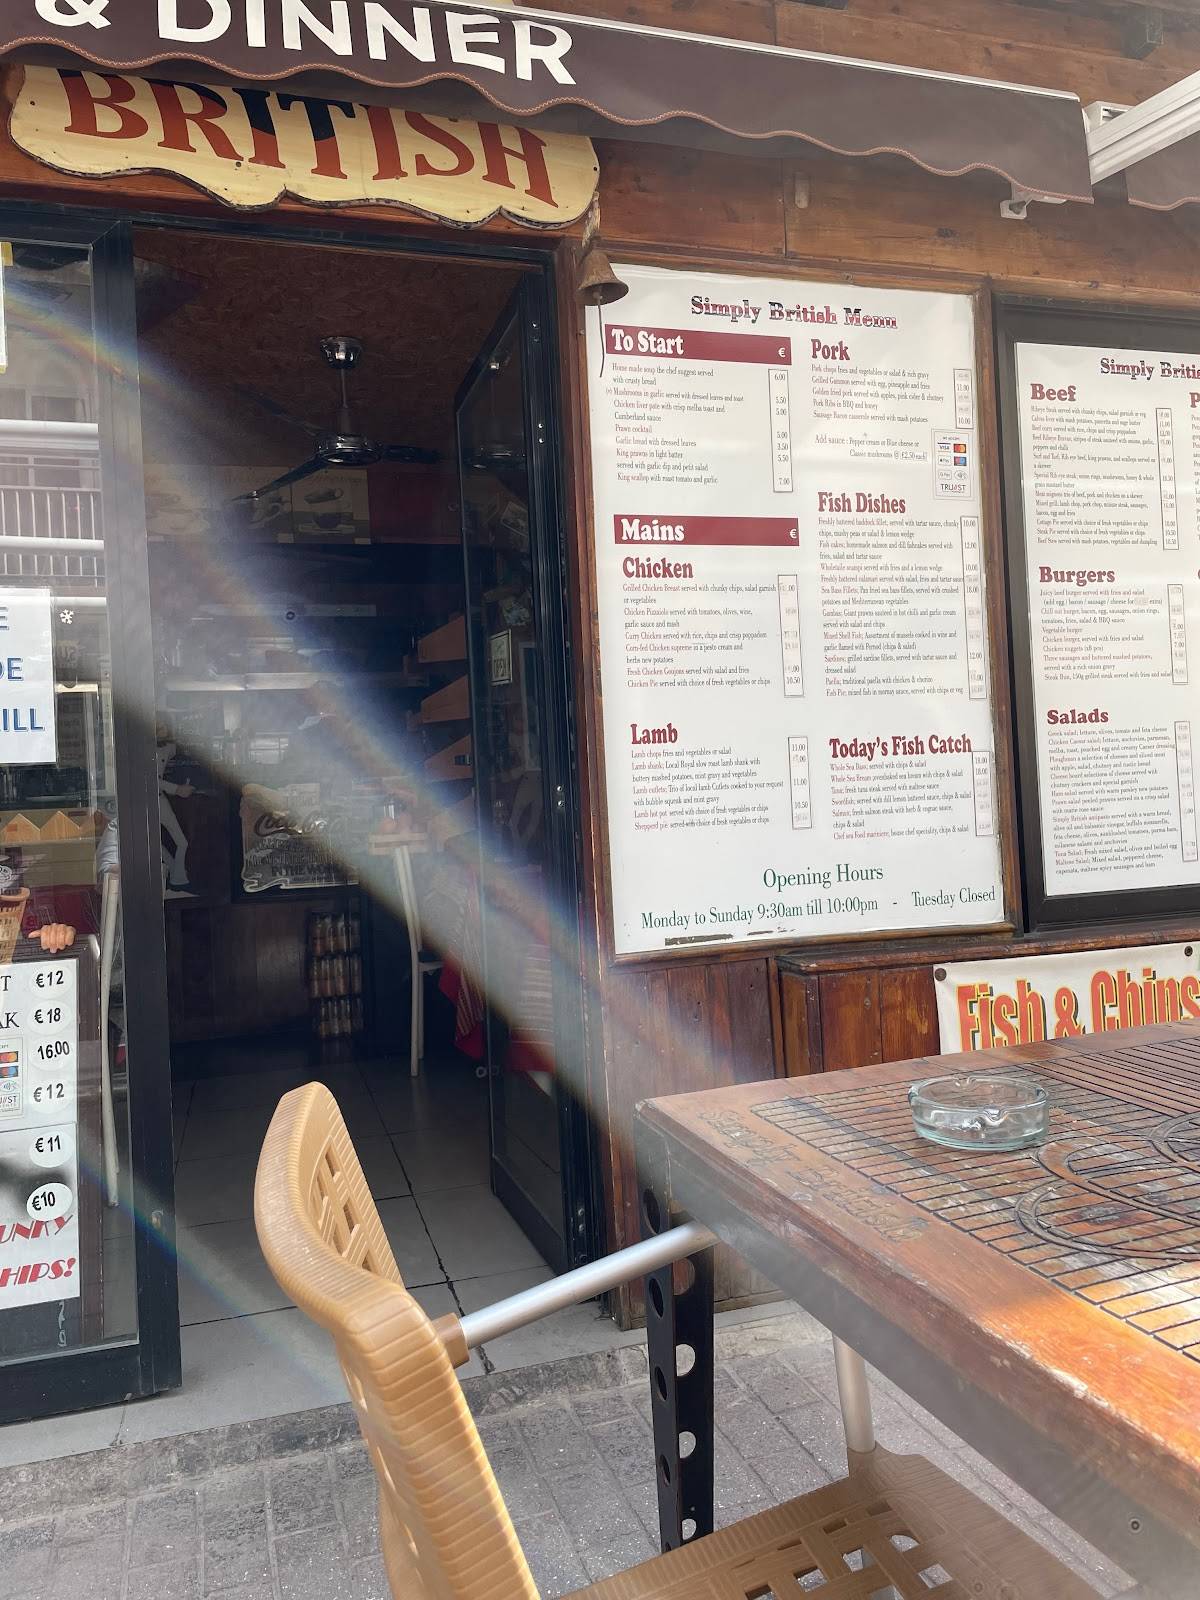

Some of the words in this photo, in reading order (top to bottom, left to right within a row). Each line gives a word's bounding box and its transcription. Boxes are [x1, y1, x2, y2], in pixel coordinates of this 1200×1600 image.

[158, 0, 578, 85] DINNER
[58, 69, 559, 208] BRITISH
[691, 296, 762, 324] Simply
[768, 301, 838, 325] British
[843, 307, 898, 329] Menu
[612, 328, 634, 351] To
[637, 331, 684, 355] Start
[778, 347, 786, 357] €
[811, 338, 850, 361] Pork
[1100, 358, 1154, 380] Simply
[1030, 383, 1076, 402] Beef
[614, 400, 635, 408] Chicken
[615, 413, 645, 421] Cumberland
[632, 425, 652, 433] cocktail
[617, 449, 629, 458] King
[656, 450, 667, 460] light
[617, 461, 633, 469] served
[647, 462, 661, 471] garlic
[618, 473, 630, 482] King
[693, 475, 703, 483] and
[818, 491, 852, 513] Fish
[856, 492, 906, 514] Dishes
[621, 518, 685, 541] Mains
[789, 529, 797, 539] €
[622, 556, 694, 578] Chicken
[1039, 566, 1116, 587] Burgers
[710, 584, 728, 594] chunky
[758, 585, 776, 594] garnish
[630, 596, 656, 605] vegetables
[0, 657, 24, 681] E
[1047, 708, 1109, 725] Salads
[630, 723, 678, 745] Lamb
[686, 748, 711, 758] vegetables
[718, 747, 731, 755] salad
[829, 737, 888, 761] Today's
[892, 736, 925, 756] Fish
[928, 734, 973, 753] Catch
[896, 761, 908, 770] chips
[909, 760, 914, 768] &
[763, 868, 832, 892] Opening
[835, 864, 884, 883] Hours
[641, 910, 690, 931] Monday
[695, 910, 706, 926] to
[709, 906, 754, 925] Sunday
[757, 903, 803, 920] 9:30am
[806, 899, 822, 916] till
[826, 897, 878, 917] 10:00pm
[912, 890, 956, 909] Tuesday
[959, 886, 996, 904] Closed
[36, 970, 64, 988] €12
[34, 1008, 61, 1024] €18
[955, 977, 1047, 1052] Fish
[1054, 986, 1086, 1039] &
[37, 1040, 70, 1060] 16.00
[33, 1083, 65, 1102] €12
[35, 1135, 61, 1153] €11
[32, 1191, 56, 1211] €10
